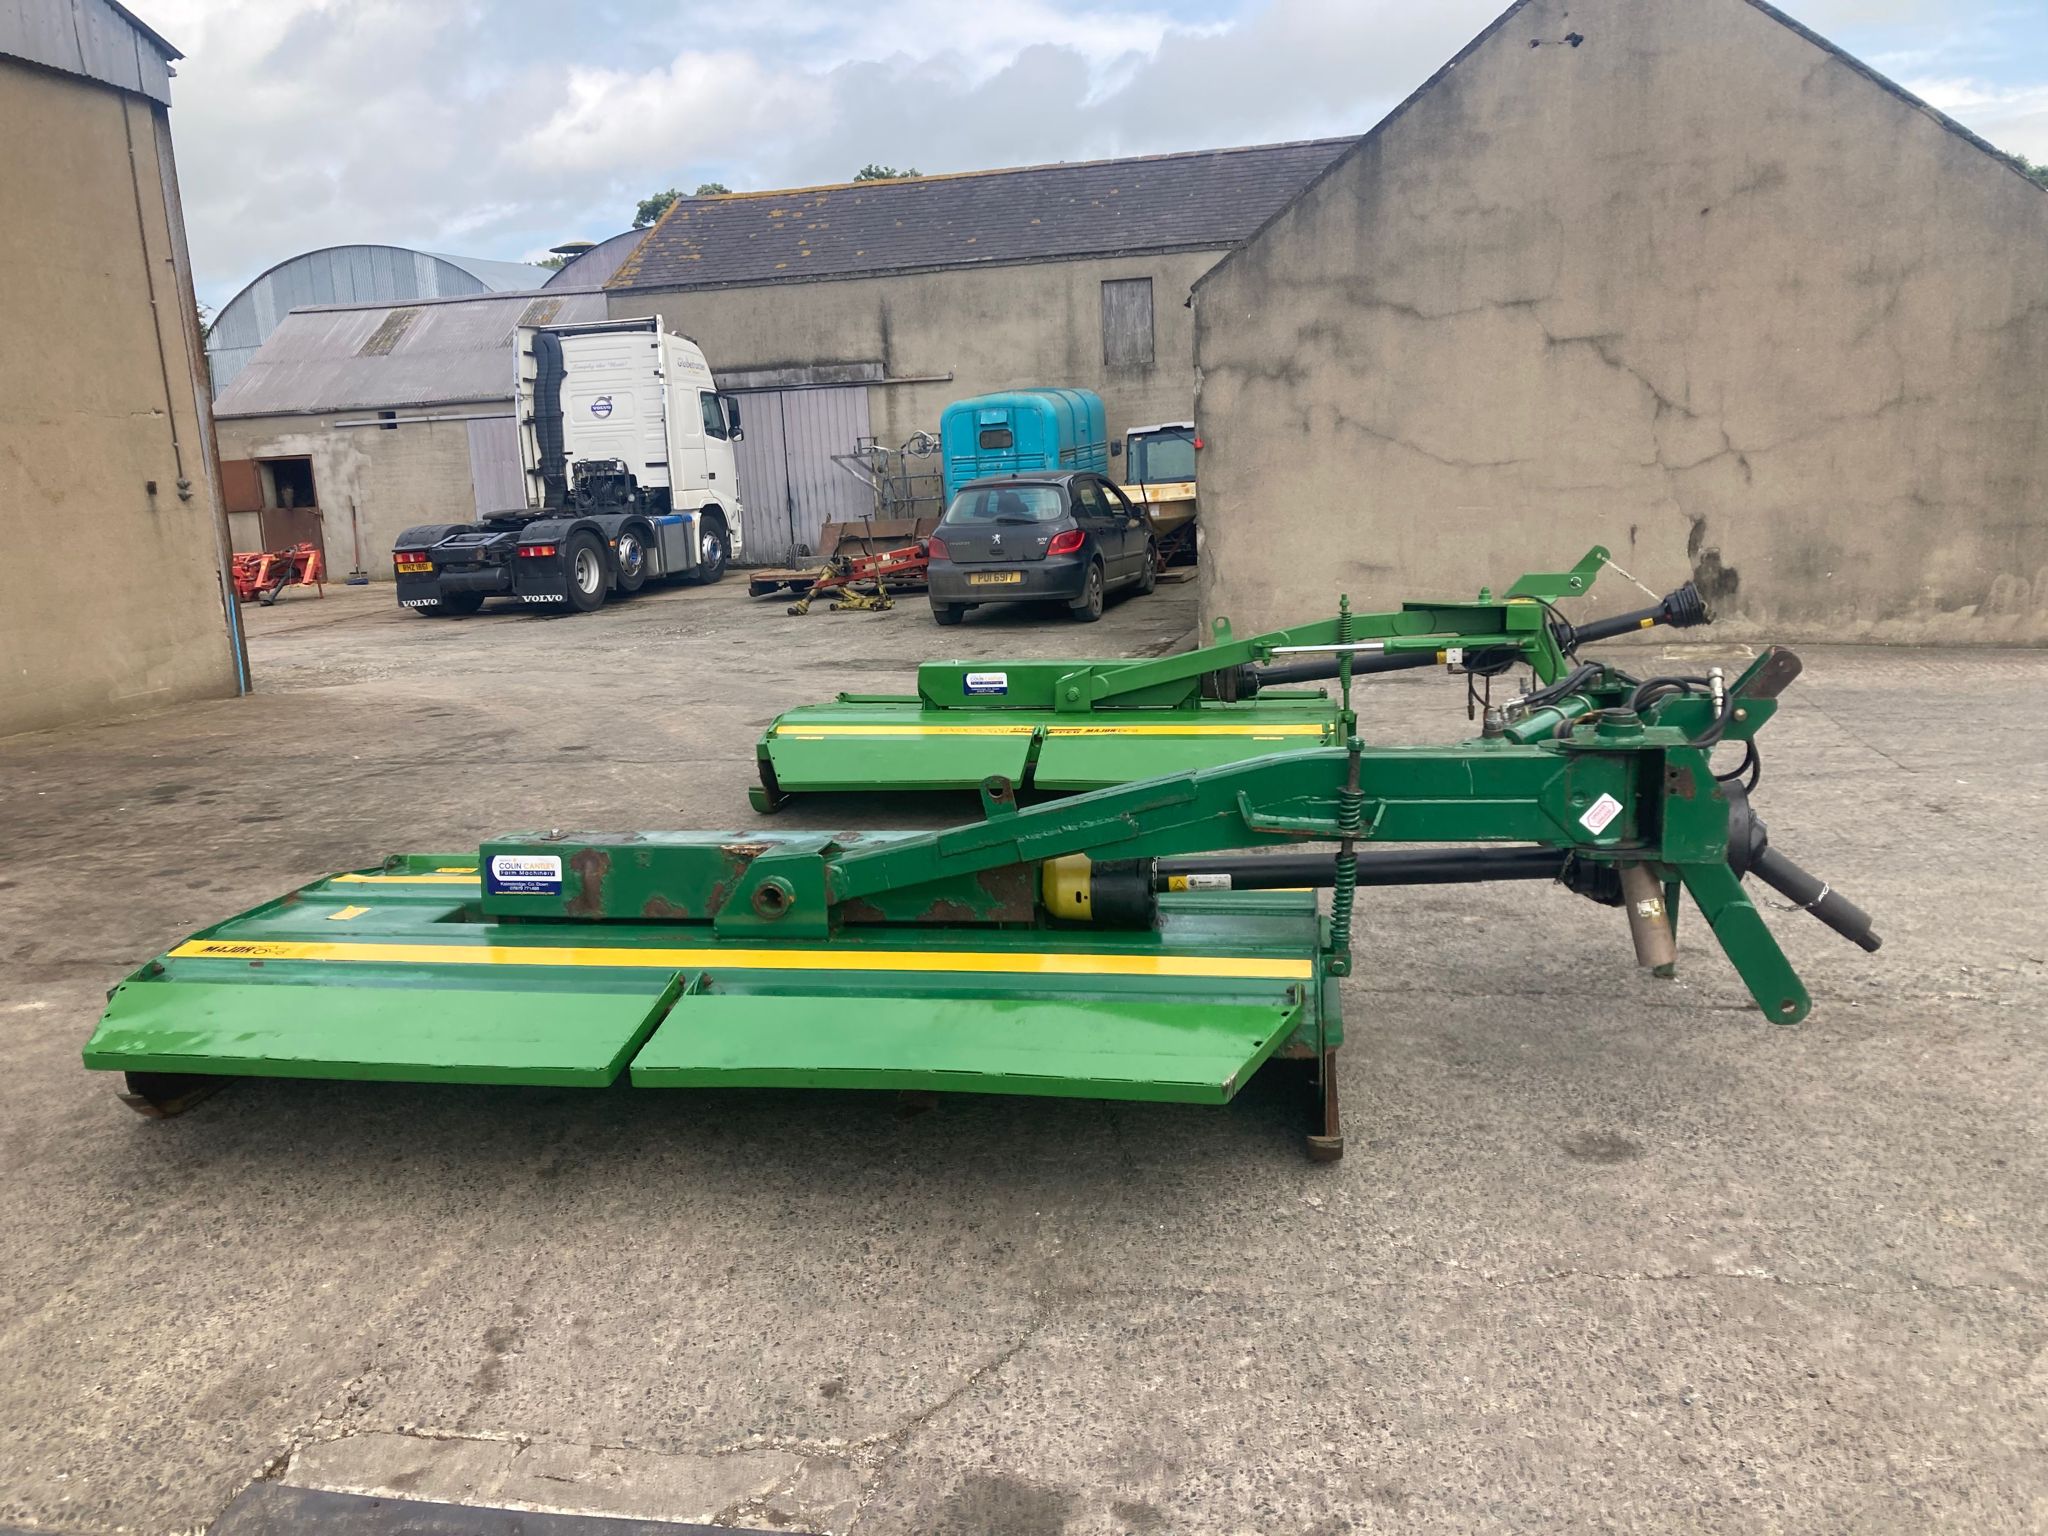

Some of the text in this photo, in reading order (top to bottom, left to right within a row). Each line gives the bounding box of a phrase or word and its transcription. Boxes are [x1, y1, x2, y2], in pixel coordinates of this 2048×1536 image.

[402, 599, 438, 607] VOLVO
[521, 595, 563, 603] VOLVO
[498, 862, 522, 870] COLIN
